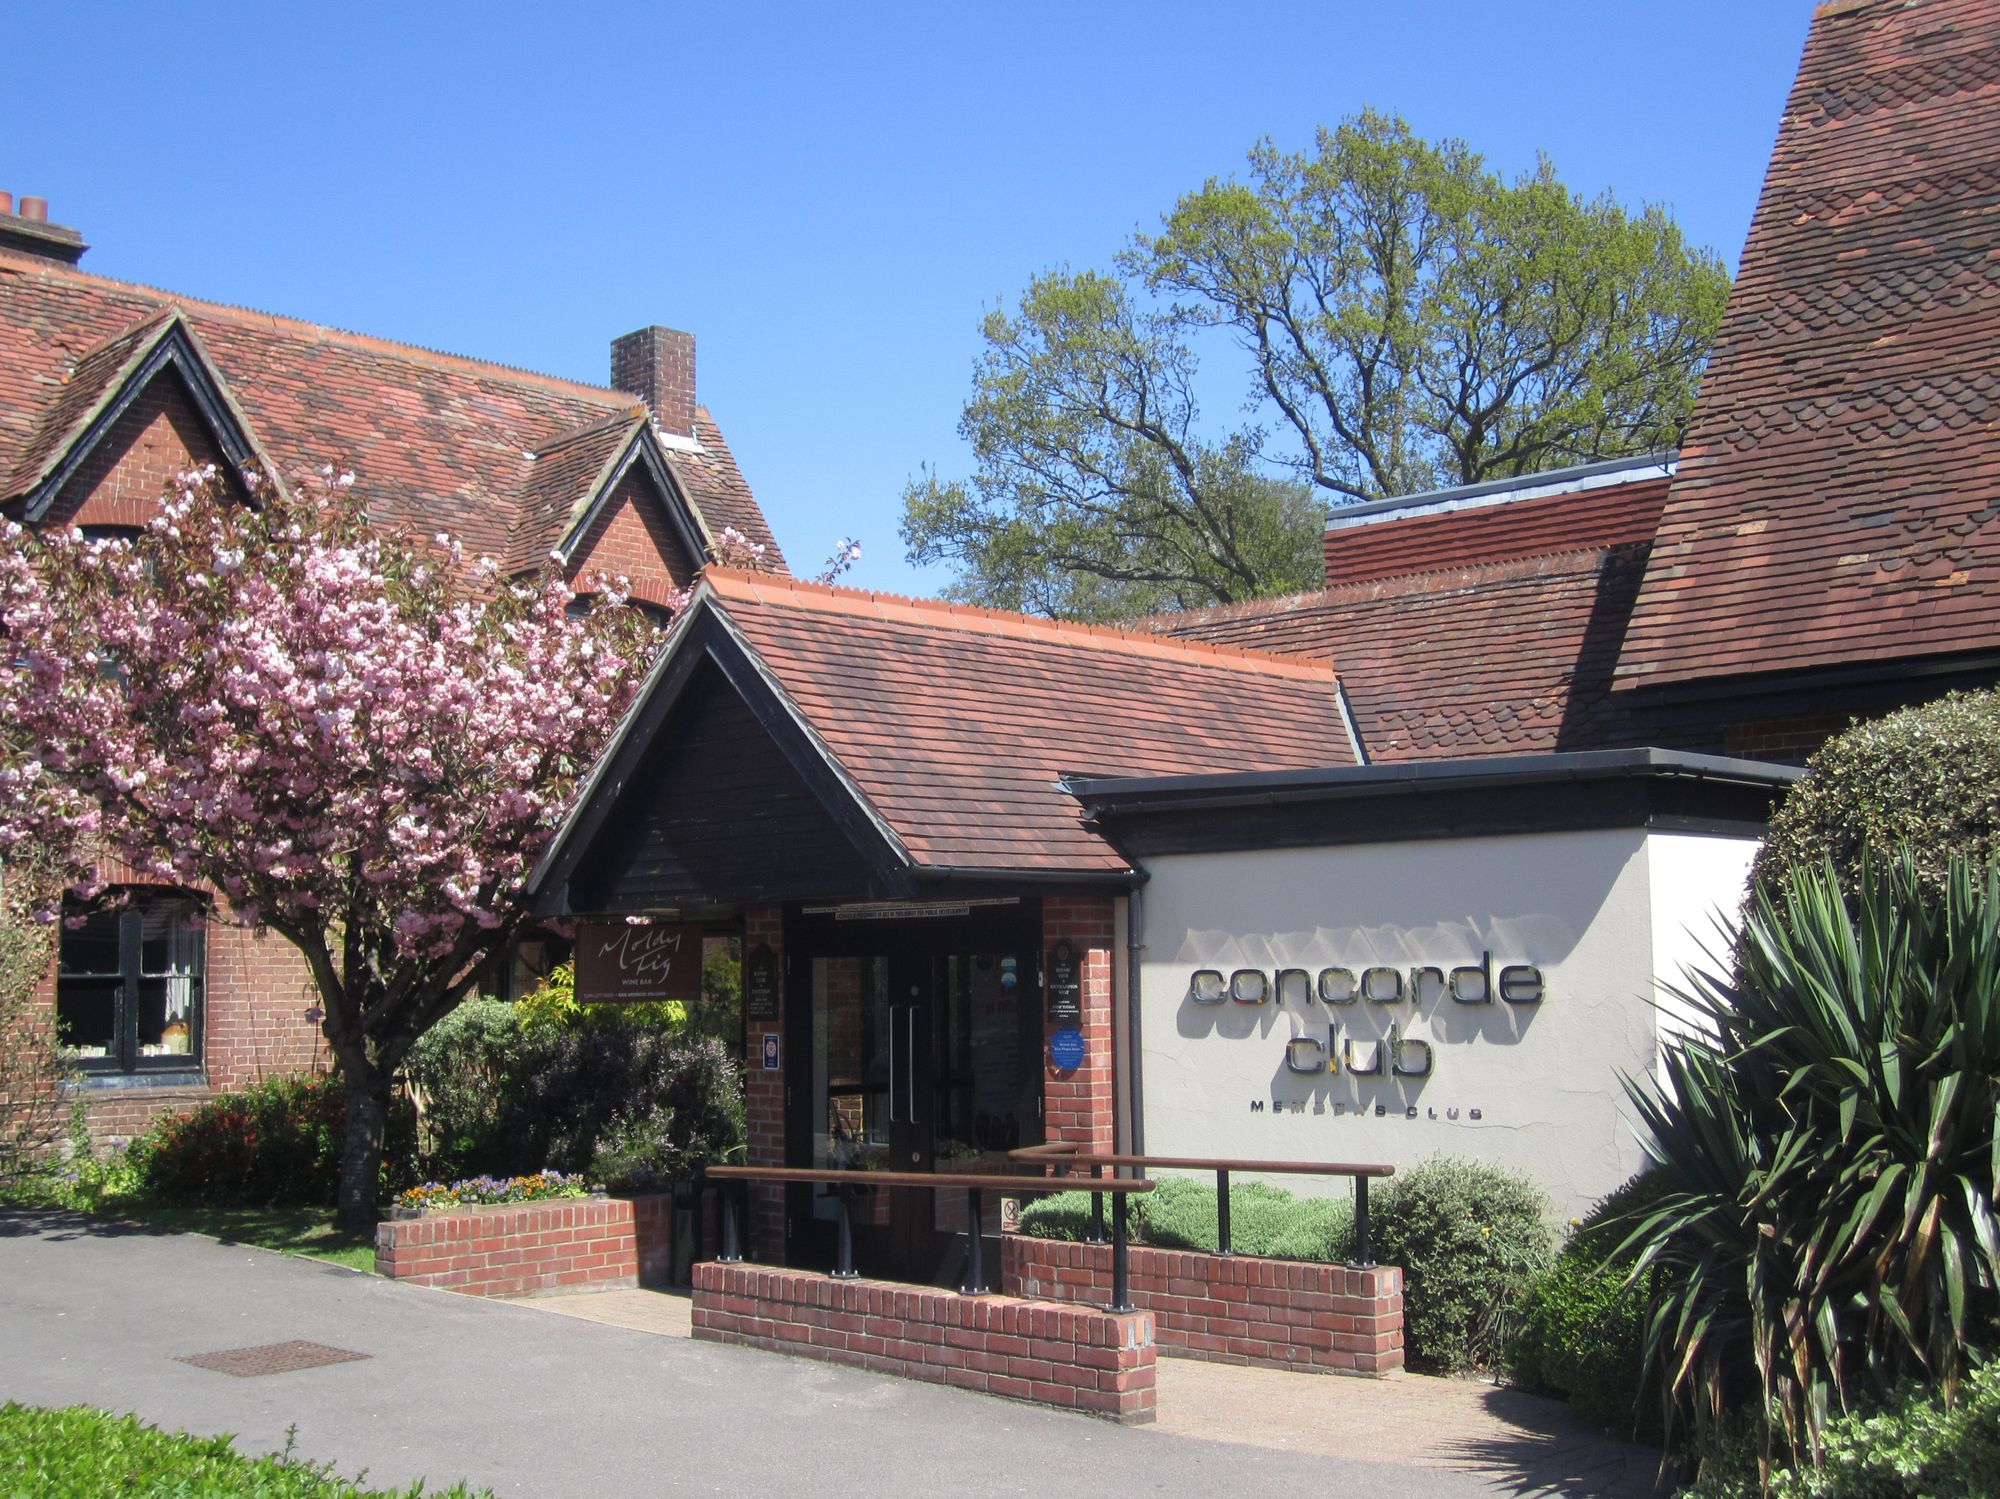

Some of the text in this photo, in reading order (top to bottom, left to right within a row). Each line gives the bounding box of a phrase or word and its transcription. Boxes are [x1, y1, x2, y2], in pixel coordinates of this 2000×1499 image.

[598, 927, 682, 970] Moldy
[622, 978, 639, 986] WINE
[1189, 951, 1544, 1005] concorde
[1286, 1023, 1435, 1077] club
[1250, 1100, 1483, 1120] MEMBERS CLUB
